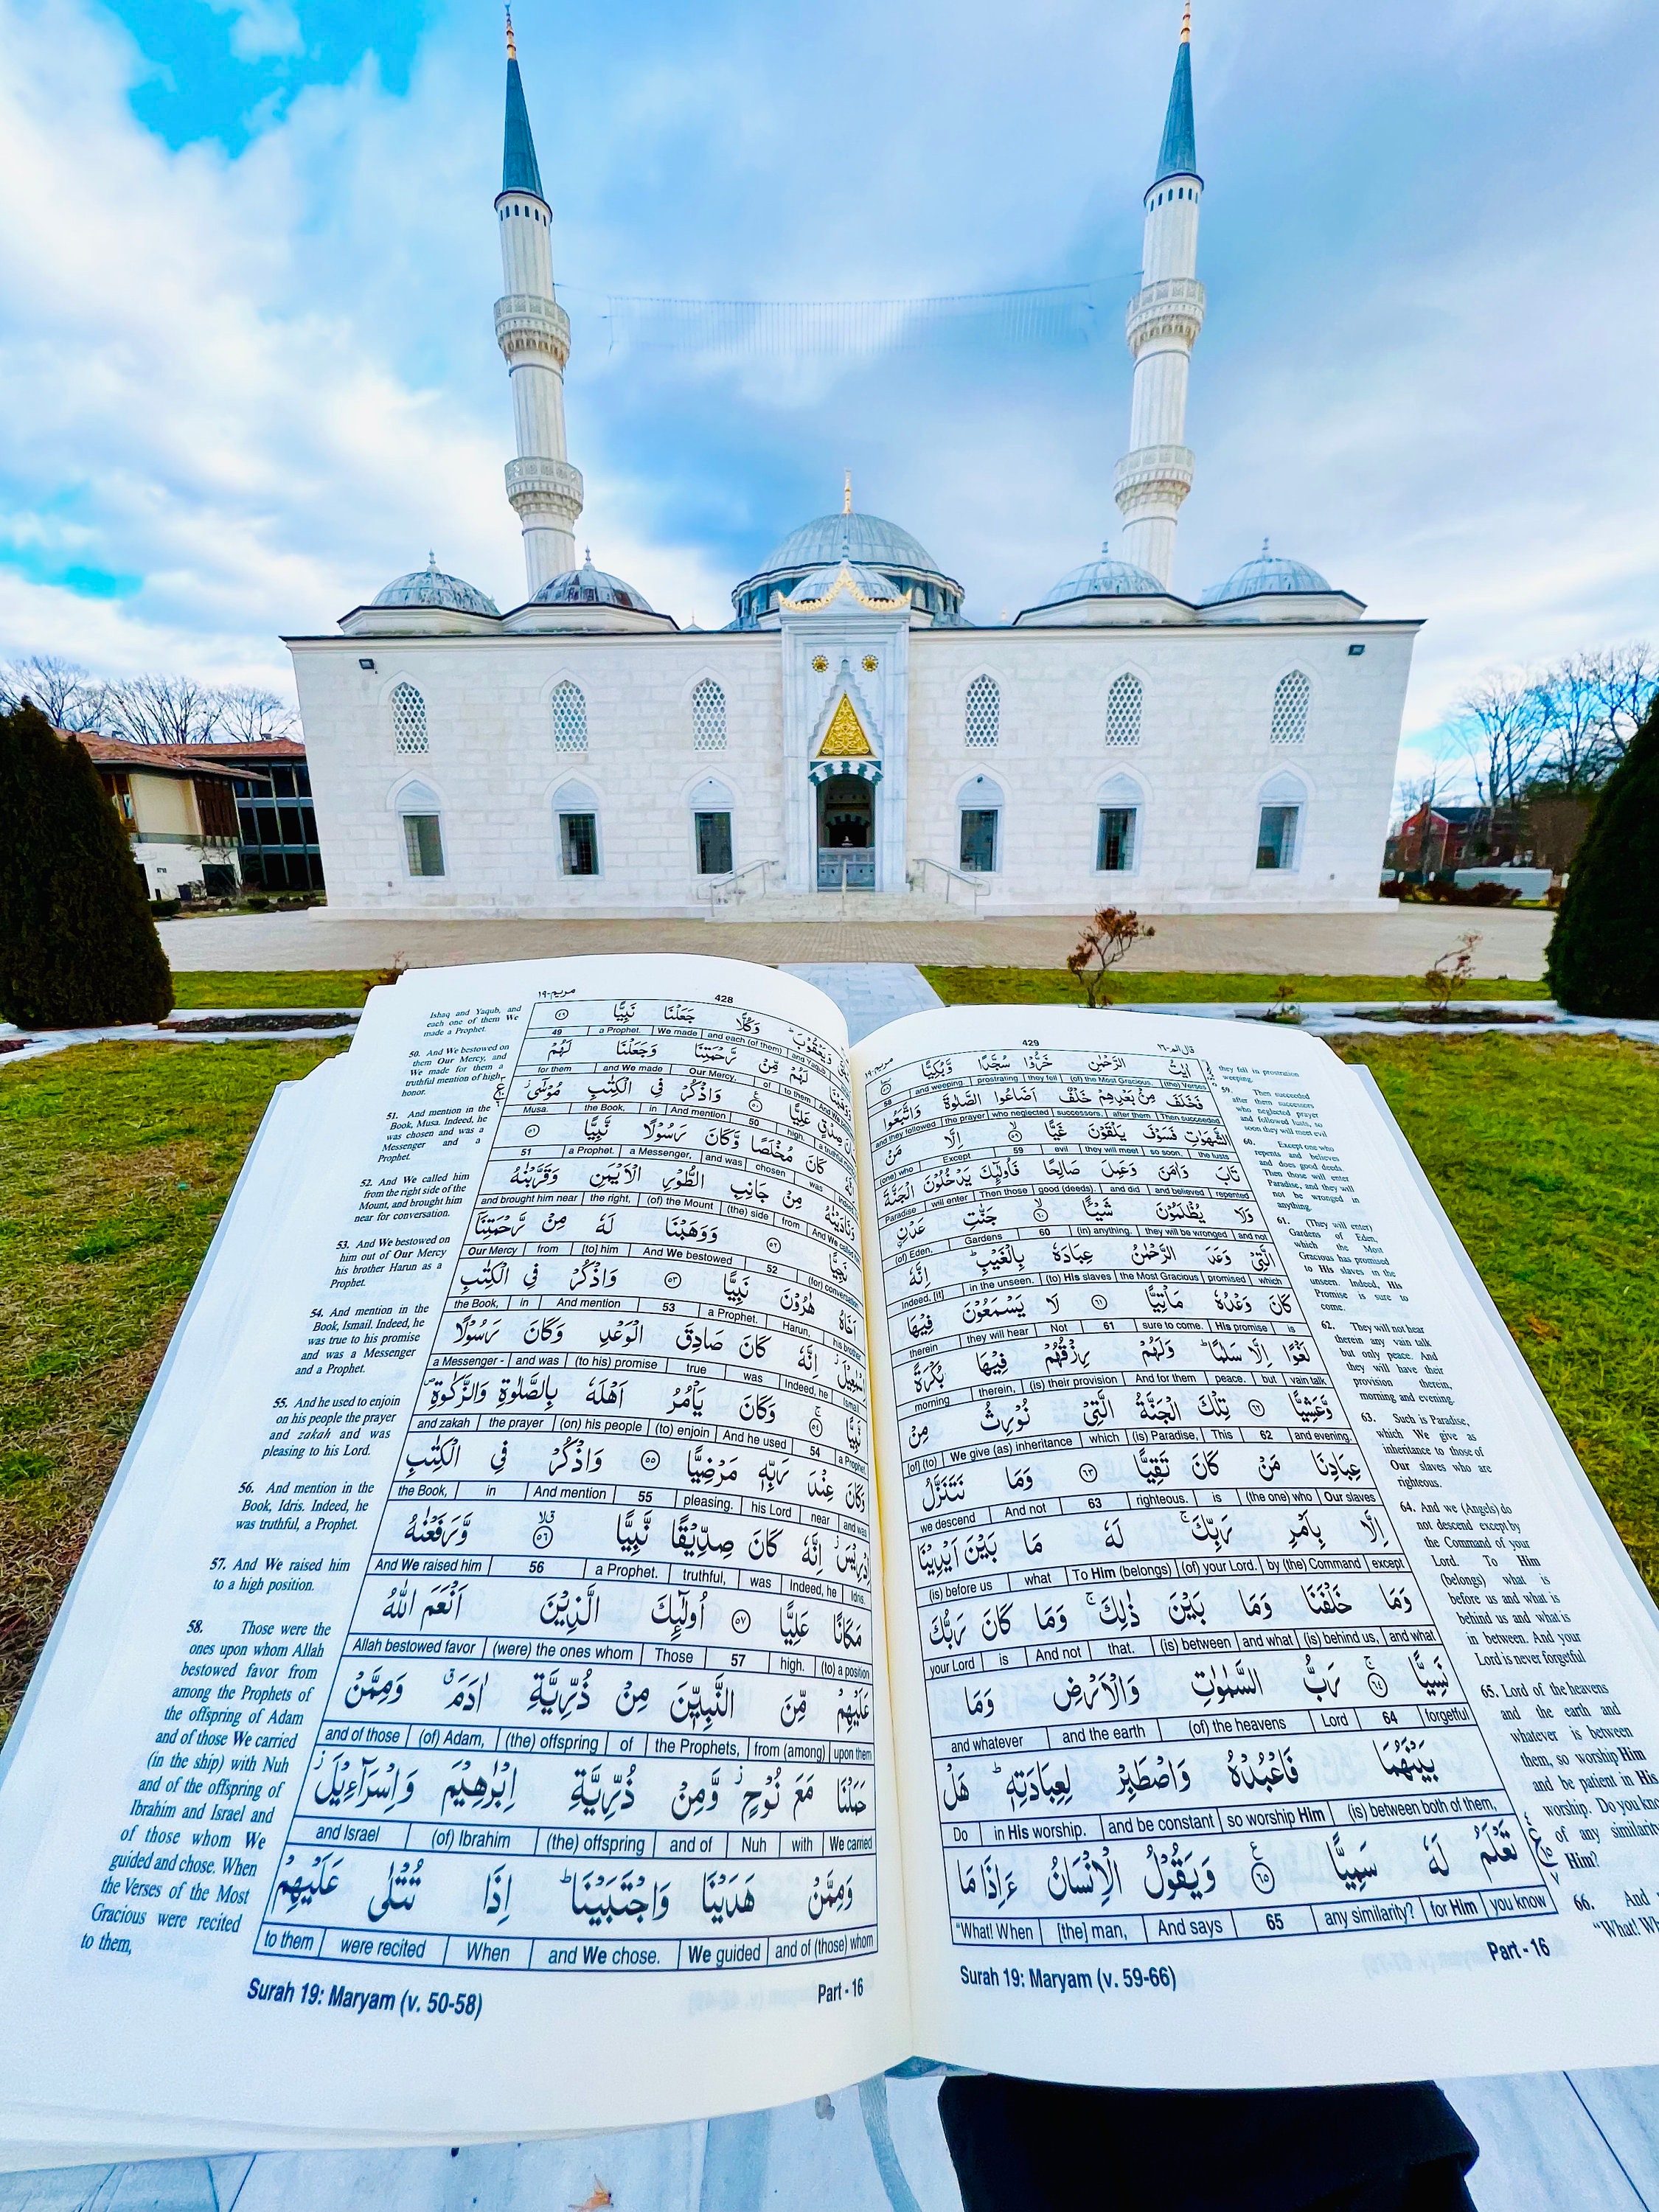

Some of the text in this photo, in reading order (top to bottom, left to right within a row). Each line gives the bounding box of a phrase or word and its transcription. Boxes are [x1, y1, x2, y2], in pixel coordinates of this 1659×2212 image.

[714, 995, 733, 1003] 428
[477, 1007, 501, 1015] Yaqub,
[378, 1177, 397, 1186] And
[422, 1173, 448, 1183] called
[364, 1184, 466, 1198] from the right side of the
[359, 1196, 462, 1210] Mount, and brought him
[481, 1196, 498, 1204] and
[501, 1194, 536, 1207] brought
[591, 1194, 605, 1202] the
[608, 1194, 630, 1204] right,
[647, 1195, 662, 1206] (of)
[667, 1197, 681, 1206] the
[684, 1198, 713, 1209] Mount
[377, 1212, 390, 1221] for
[393, 1211, 450, 1220] conversation.
[964, 1232, 1005, 1246] Gardens
[1076, 1225, 1093, 1237] (in)
[1092, 1224, 1135, 1237] anything.
[1145, 1227, 1164, 1238] they
[1178, 1228, 1192, 1239] be
[1190, 1228, 1229, 1241] wronged
[1361, 1413, 1470, 1427] 63. Such is Paradise,
[238, 1481, 374, 1493] 56. And mention in the
[241, 1499, 369, 1514] Book, Idris. Indeed, he
[236, 1517, 358, 1534] was truthful, a Prophet.
[210, 1557, 350, 1571] 57. And We raised him
[213, 1577, 314, 1594] to a high position.
[187, 1620, 331, 1635] 58. Those were the
[1481, 1683, 1609, 1698] 65. Lord of the heavens
[325, 1727, 872, 1761] and of those (of) Adam, (the) offspring of the Prophets, from (among) upon them
[92, 1903, 243, 1933] Gracious were recited
[996, 1923, 1033, 1939] When
[1091, 1925, 1127, 1940] man,
[1159, 1918, 1186, 1936] And
[1190, 1920, 1222, 1938] says
[1266, 1913, 1284, 1930] 65
[1325, 1911, 1347, 1929] any
[1352, 1902, 1414, 1923] similarity?
[1430, 1901, 1447, 1917] for
[1449, 1899, 1478, 1916] Him
[1490, 1899, 1515, 1913] you
[1514, 1894, 1546, 1909] know
[81, 1933, 132, 1955] to them,
[264, 1930, 873, 1967] to them were recited When and We chose. We guided and of (those) whom
[1486, 1941, 1520, 1961] Part
[1531, 1938, 1550, 1957] 16
[961, 1965, 1176, 1993] Surah 19: Maryam (v. 59-66)
[818, 1982, 841, 2003] Part
[852, 1978, 863, 1997] 16
[247, 1978, 482, 2021] Surah 19: Maryam (v. 50-58)
